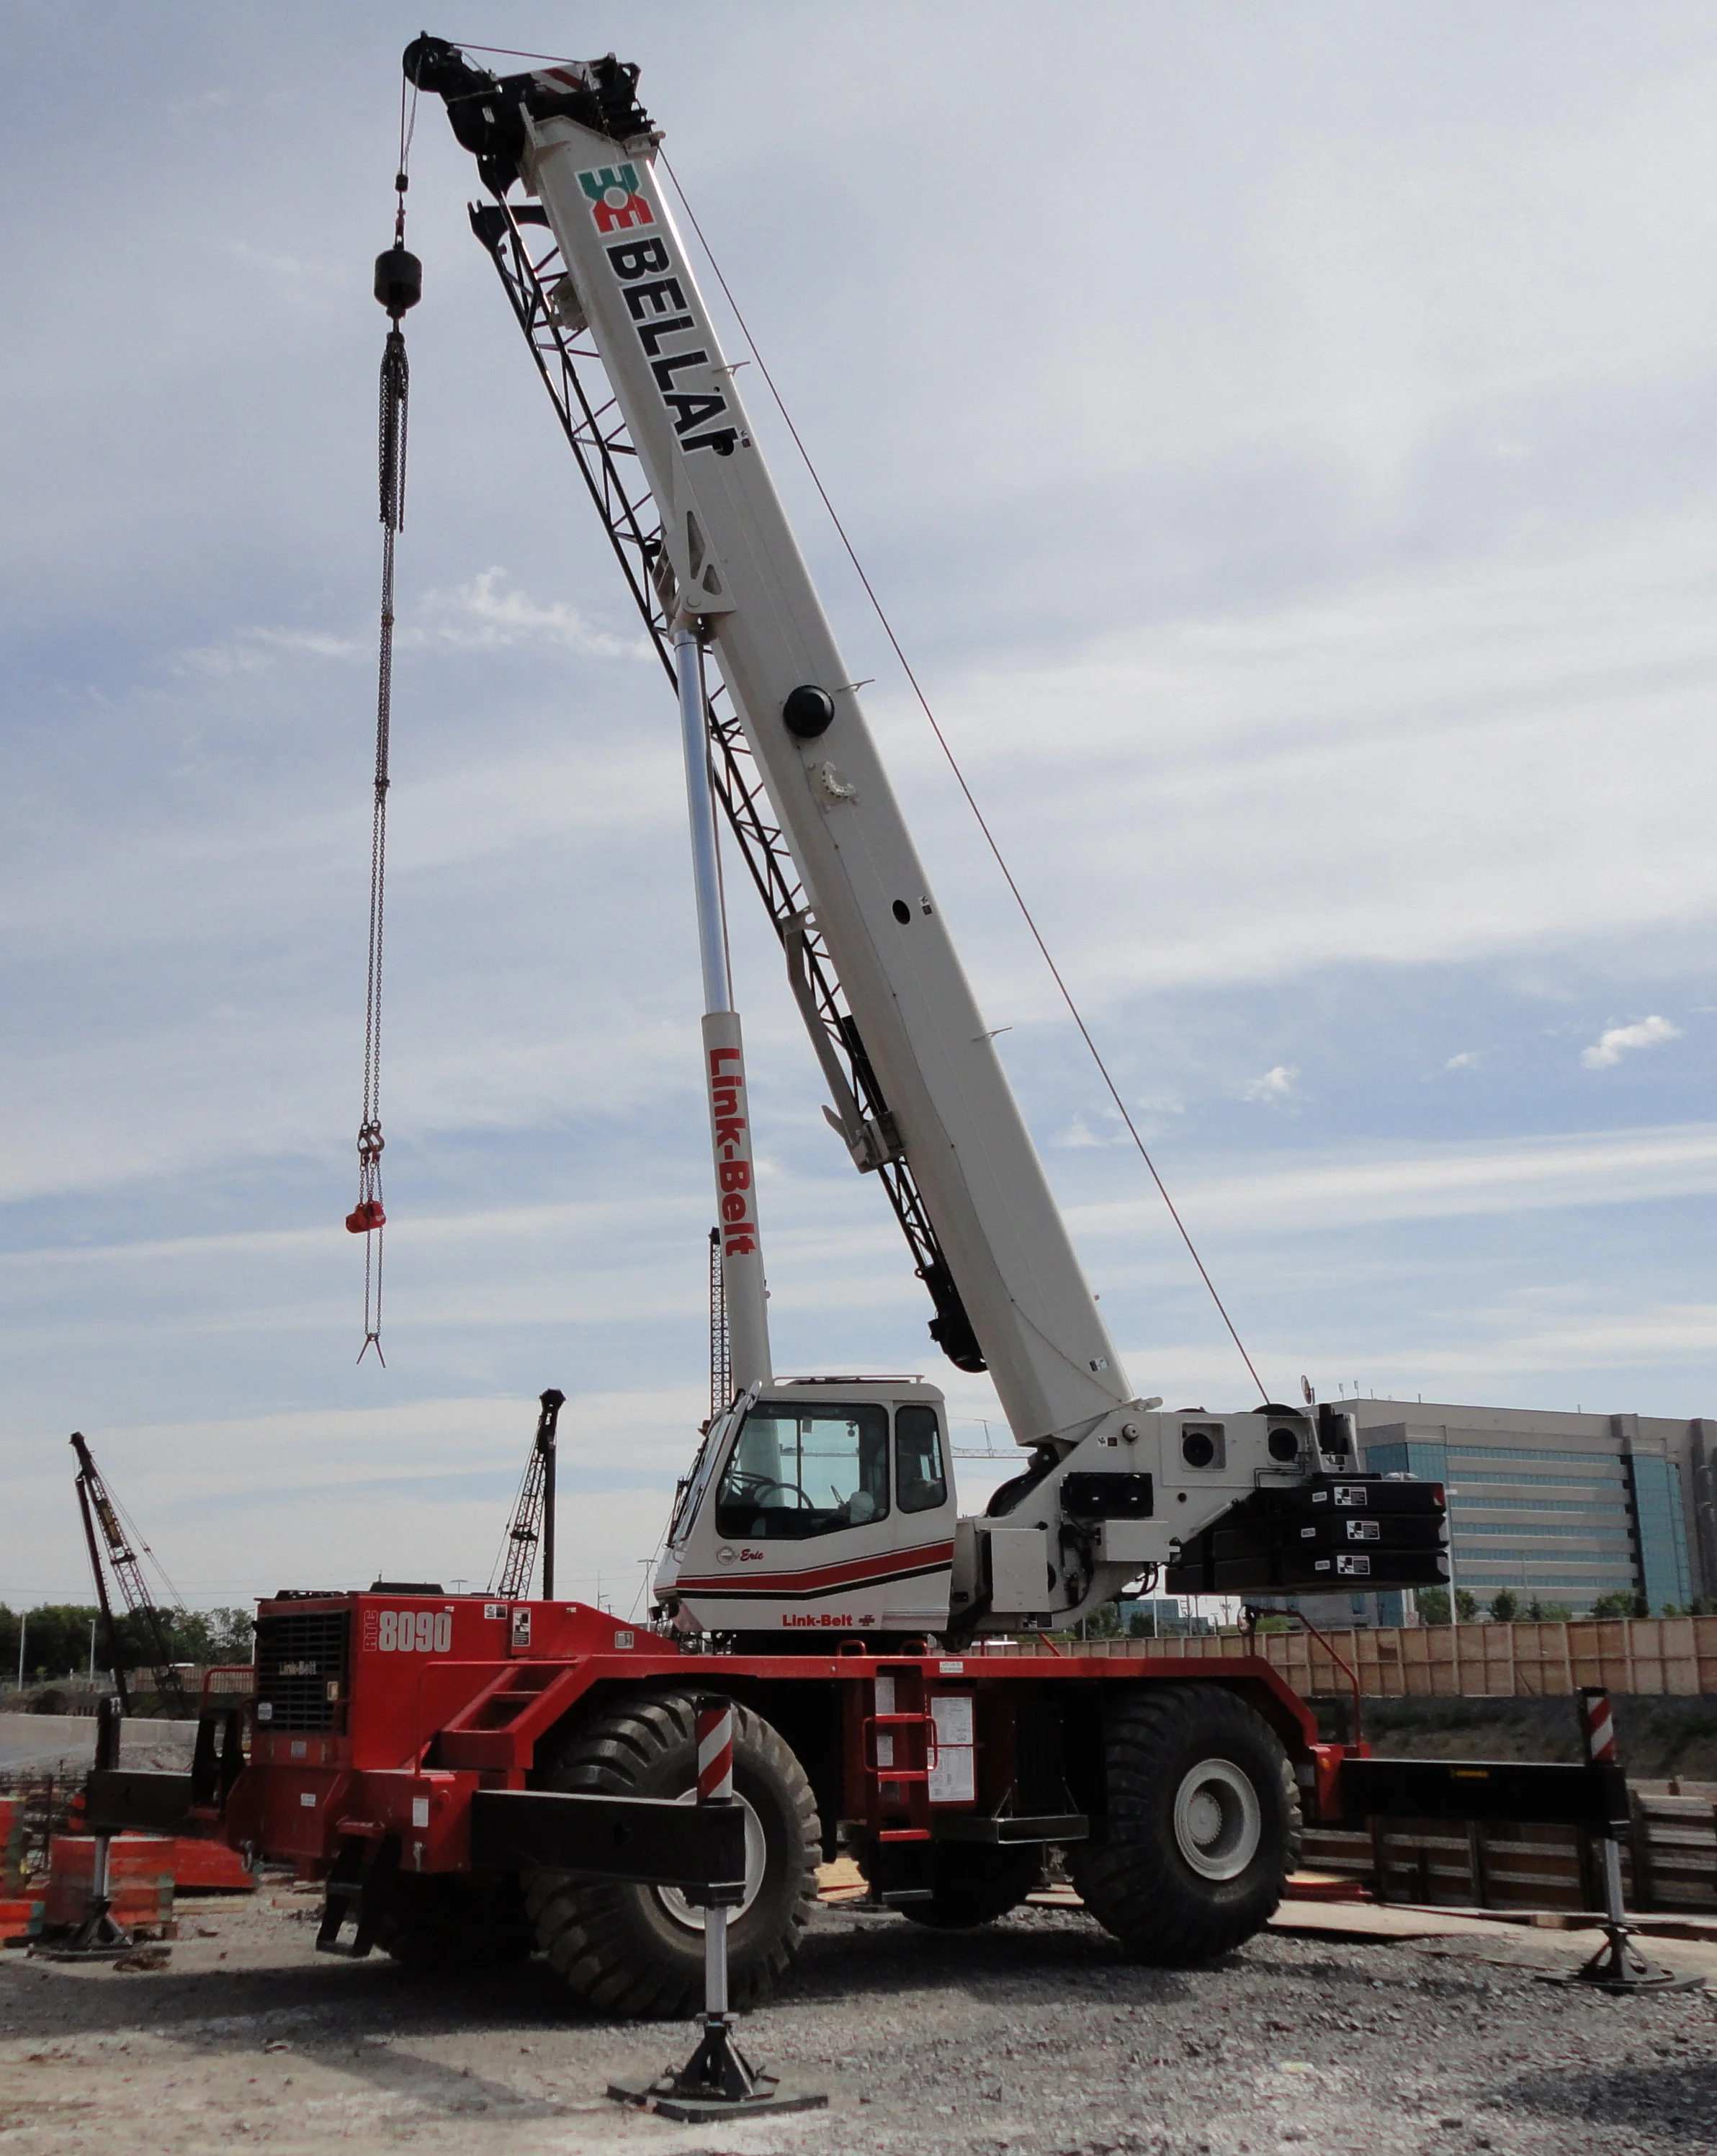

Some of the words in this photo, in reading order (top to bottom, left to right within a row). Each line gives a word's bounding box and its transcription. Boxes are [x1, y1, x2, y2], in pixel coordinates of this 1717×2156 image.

[709, 1048, 756, 1257] Link-Belt
[740, 1548, 763, 1562] Eric
[362, 1610, 378, 1651] RTC
[379, 1611, 451, 1652] 8090
[782, 1614, 853, 1627] Link-Belt
